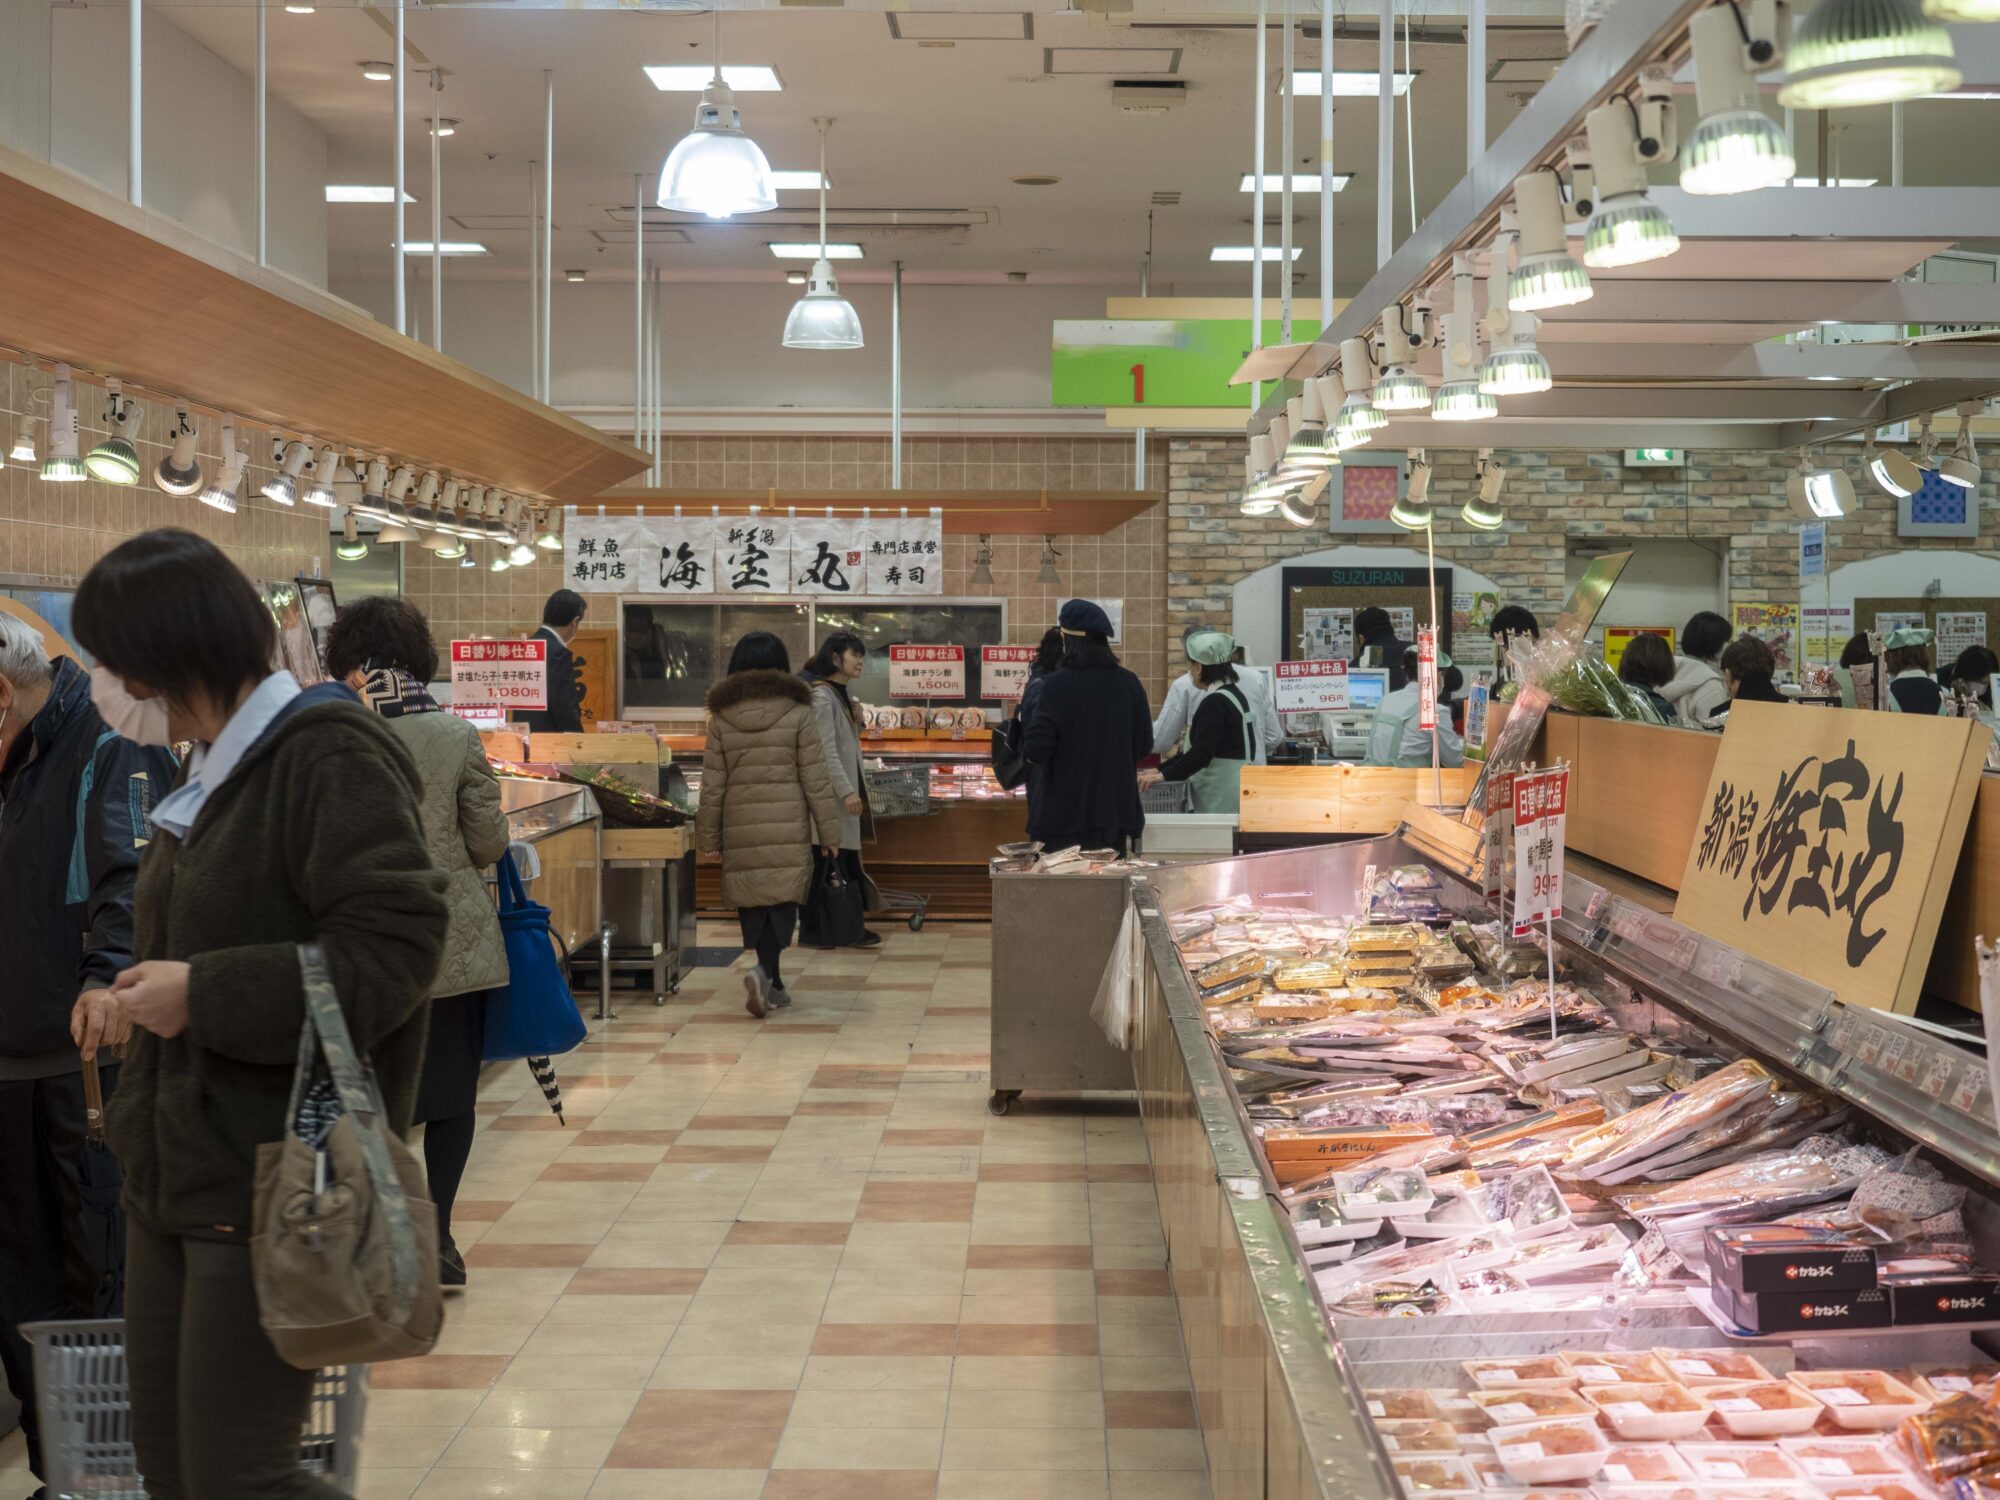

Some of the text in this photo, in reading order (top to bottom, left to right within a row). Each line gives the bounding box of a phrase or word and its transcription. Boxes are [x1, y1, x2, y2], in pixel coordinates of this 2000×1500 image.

[1130, 364, 1145, 403] 1
[577, 537, 620, 558] 鮮魚
[870, 540, 937, 555] 専門店直営
[572, 561, 626, 581] 専門店
[885, 565, 925, 585] 寿司
[1331, 570, 1404, 585] SUZURAN
[460, 644, 538, 658] 日替り奉仕品
[896, 649, 958, 660] 日替り奉仕品
[1280, 662, 1343, 676] 日替り奉仕品
[487, 687, 540, 698] 1,080円
[1319, 694, 1344, 703] 96円
[1697, 780, 1759, 880] 新潟
[1533, 873, 1558, 898] 99円
[1799, 1265, 1834, 1277] かねふく
[1814, 1304, 1849, 1316] かねふく
[1951, 1297, 1985, 1309] かねふく
